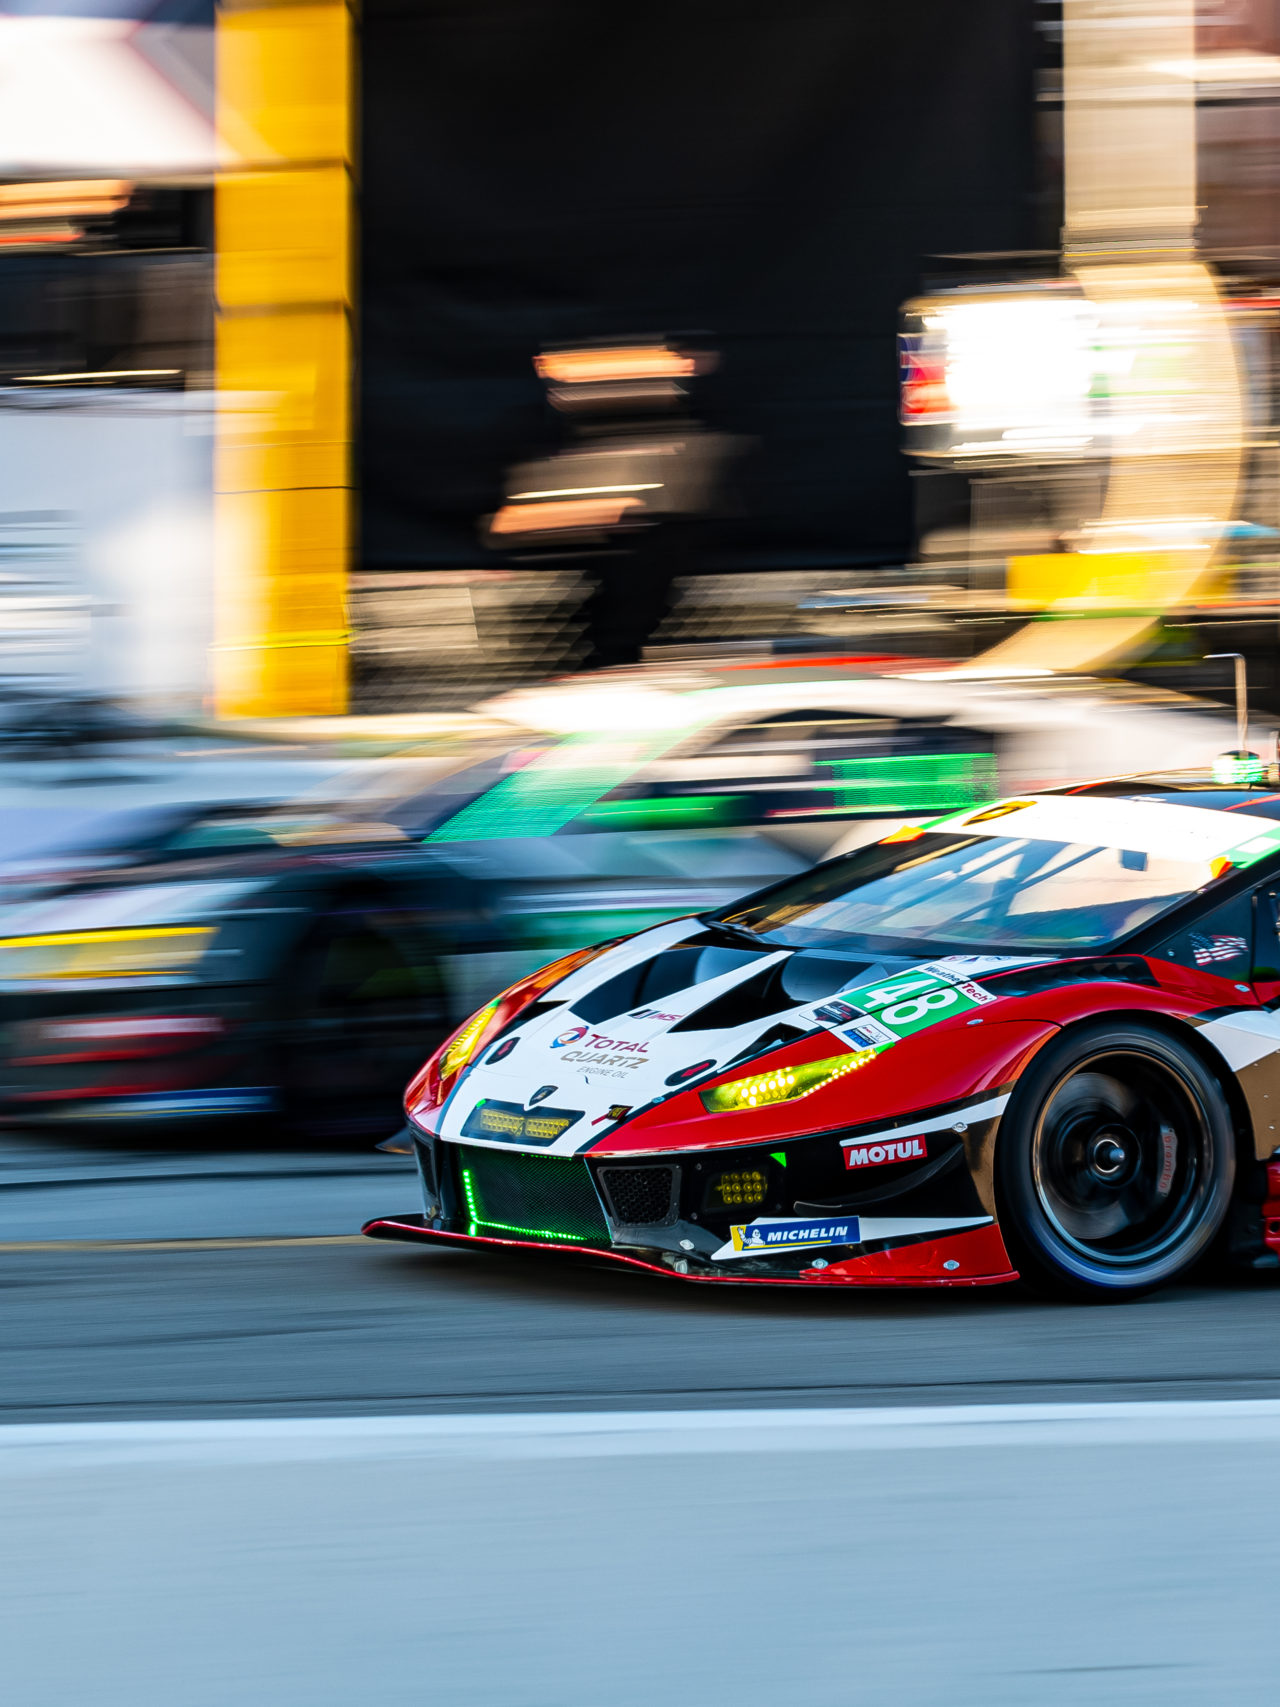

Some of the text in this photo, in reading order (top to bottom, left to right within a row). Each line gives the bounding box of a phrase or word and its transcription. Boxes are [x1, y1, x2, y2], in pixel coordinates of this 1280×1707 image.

[863, 978, 959, 1025] 48
[584, 1033, 650, 1053] TOTAL
[560, 1051, 649, 1069] QUARTZ
[576, 1065, 629, 1079] ENGINE OIL
[849, 1139, 924, 1167] MOTUL
[767, 1226, 848, 1242] MICHELIN
